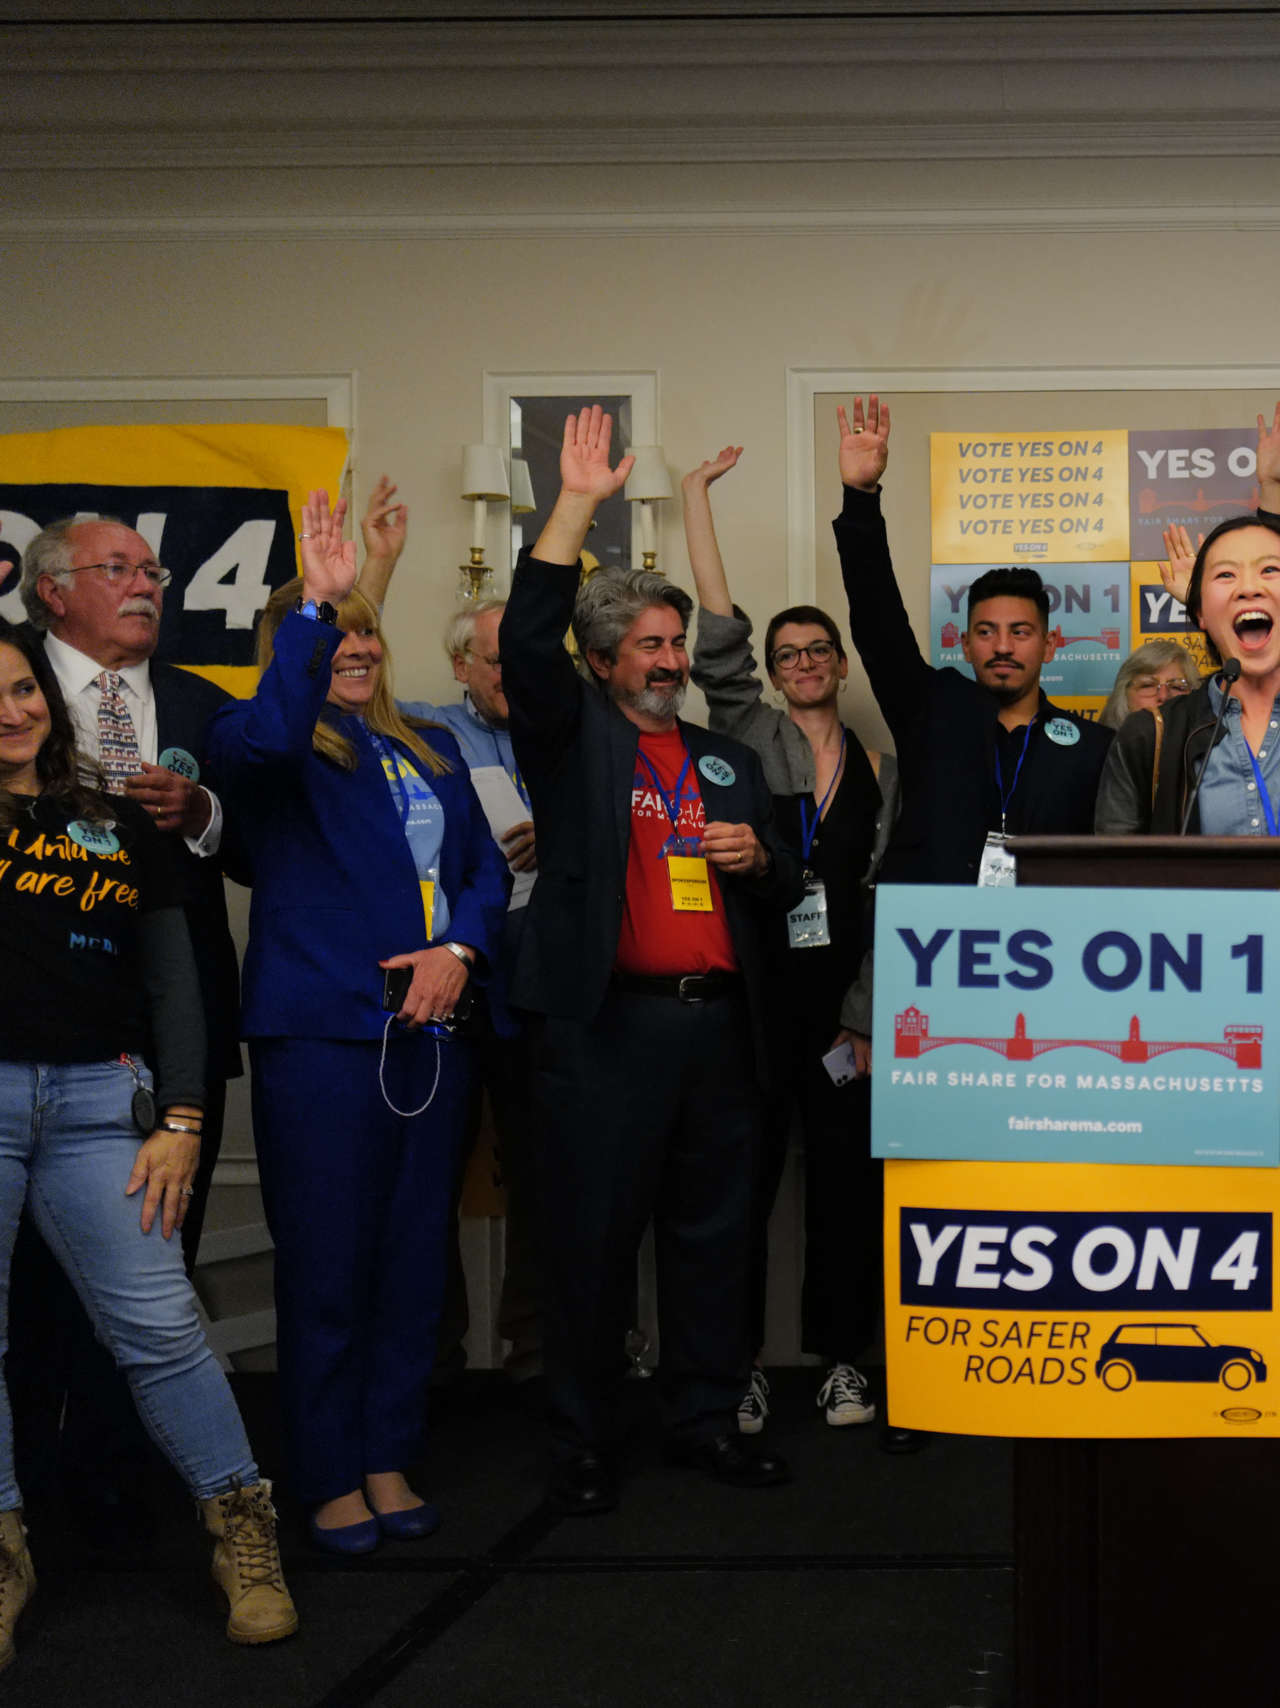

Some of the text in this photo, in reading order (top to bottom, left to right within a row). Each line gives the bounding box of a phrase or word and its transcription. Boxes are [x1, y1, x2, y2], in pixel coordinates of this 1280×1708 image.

[959, 441, 1103, 458] VOTE YES ON 4
[1137, 448, 1215, 479] YES
[1228, 447, 1256, 477] O
[959, 467, 1104, 484] VOTE YES ON 4
[959, 492, 1104, 510] VOTE YES ON 4
[959, 518, 1104, 536] VOTE YES ON 4
[183, 519, 276, 630] 4
[1104, 584, 1120, 613] 1
[1145, 592, 1190, 623] YE
[1054, 653, 1121, 662] SACHUSETTS
[1052, 722, 1073, 732] YES
[1052, 729, 1067, 737] ON
[172, 754, 193, 775] YES
[631, 789, 668, 816] FAI
[82, 834, 102, 845] ON
[15, 870, 76, 897] are
[790, 911, 825, 924] STAFF
[895, 928, 1263, 994] YES ON 1
[891, 1071, 1263, 1093] FAIR SHARE FOR MASSACHUSETTS
[1008, 1116, 1142, 1133] fairsharema.com
[909, 1223, 1260, 1292] YES ON 4
[905, 1316, 1090, 1349] FOR SAFER
[964, 1355, 1088, 1385] ROADS
